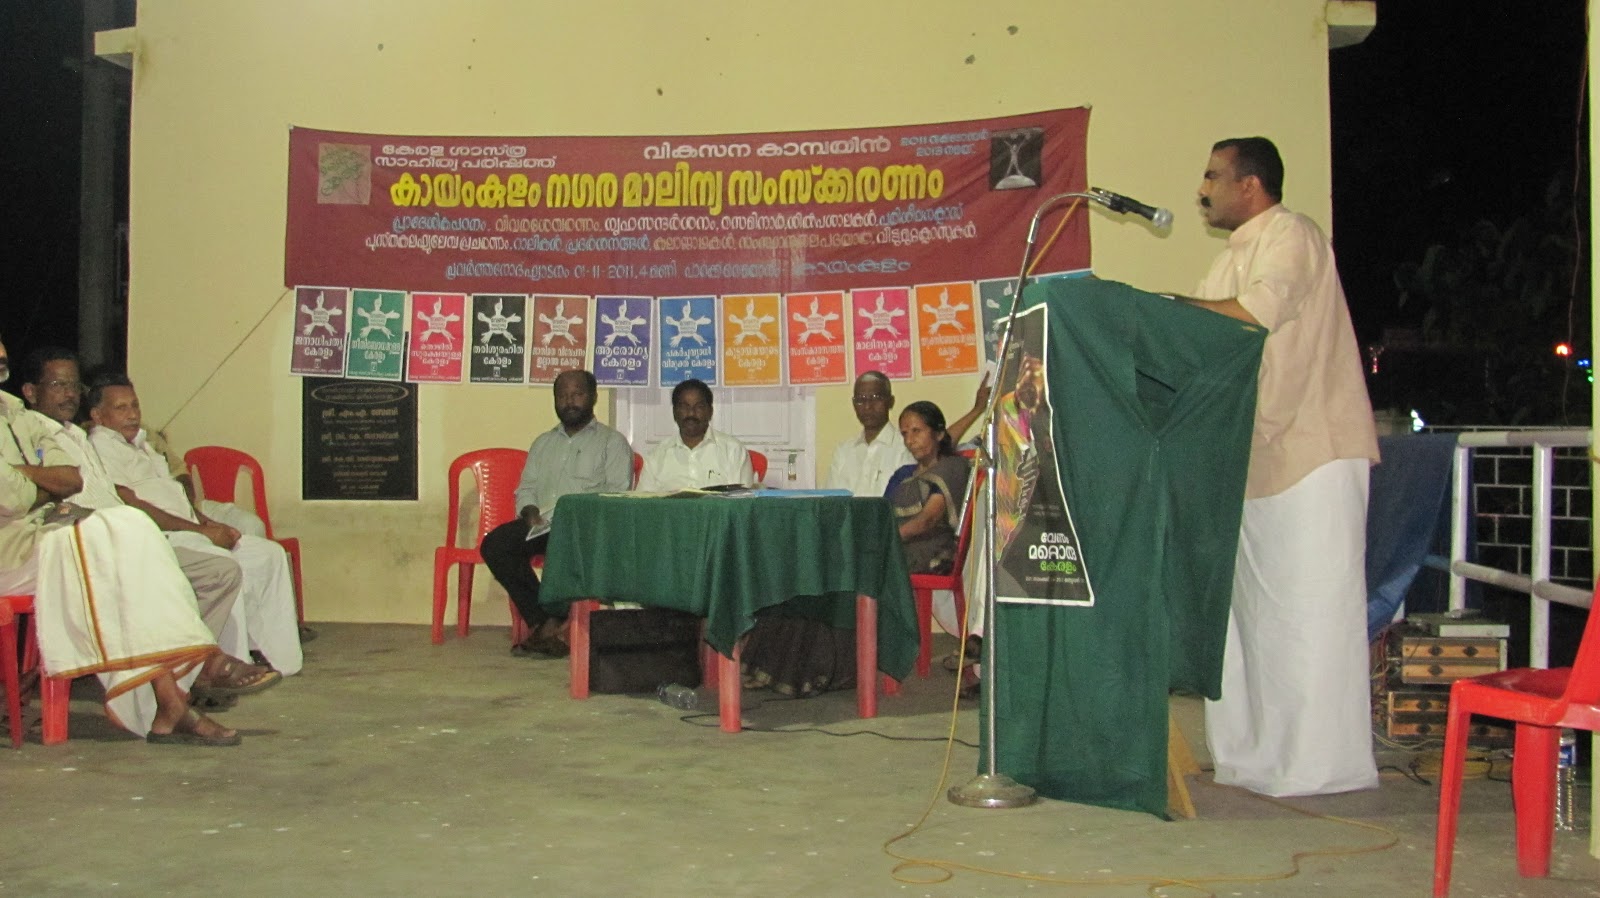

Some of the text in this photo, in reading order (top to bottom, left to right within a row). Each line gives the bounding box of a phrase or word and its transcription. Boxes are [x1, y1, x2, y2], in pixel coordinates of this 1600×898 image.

[382, 144, 527, 158] കേരള ശാസ്ത്ര
[643, 135, 891, 159] വികസന കാമ്പയിൻ
[375, 155, 557, 171] സാഹിത്യ പരിഷത്ത്
[390, 172, 542, 208] കായംകുളം
[546, 173, 619, 208] നഗര
[622, 161, 722, 216] മാലിന്യ
[595, 346, 648, 360] ആരോഗ്യ
[601, 357, 642, 370] കേരളം
